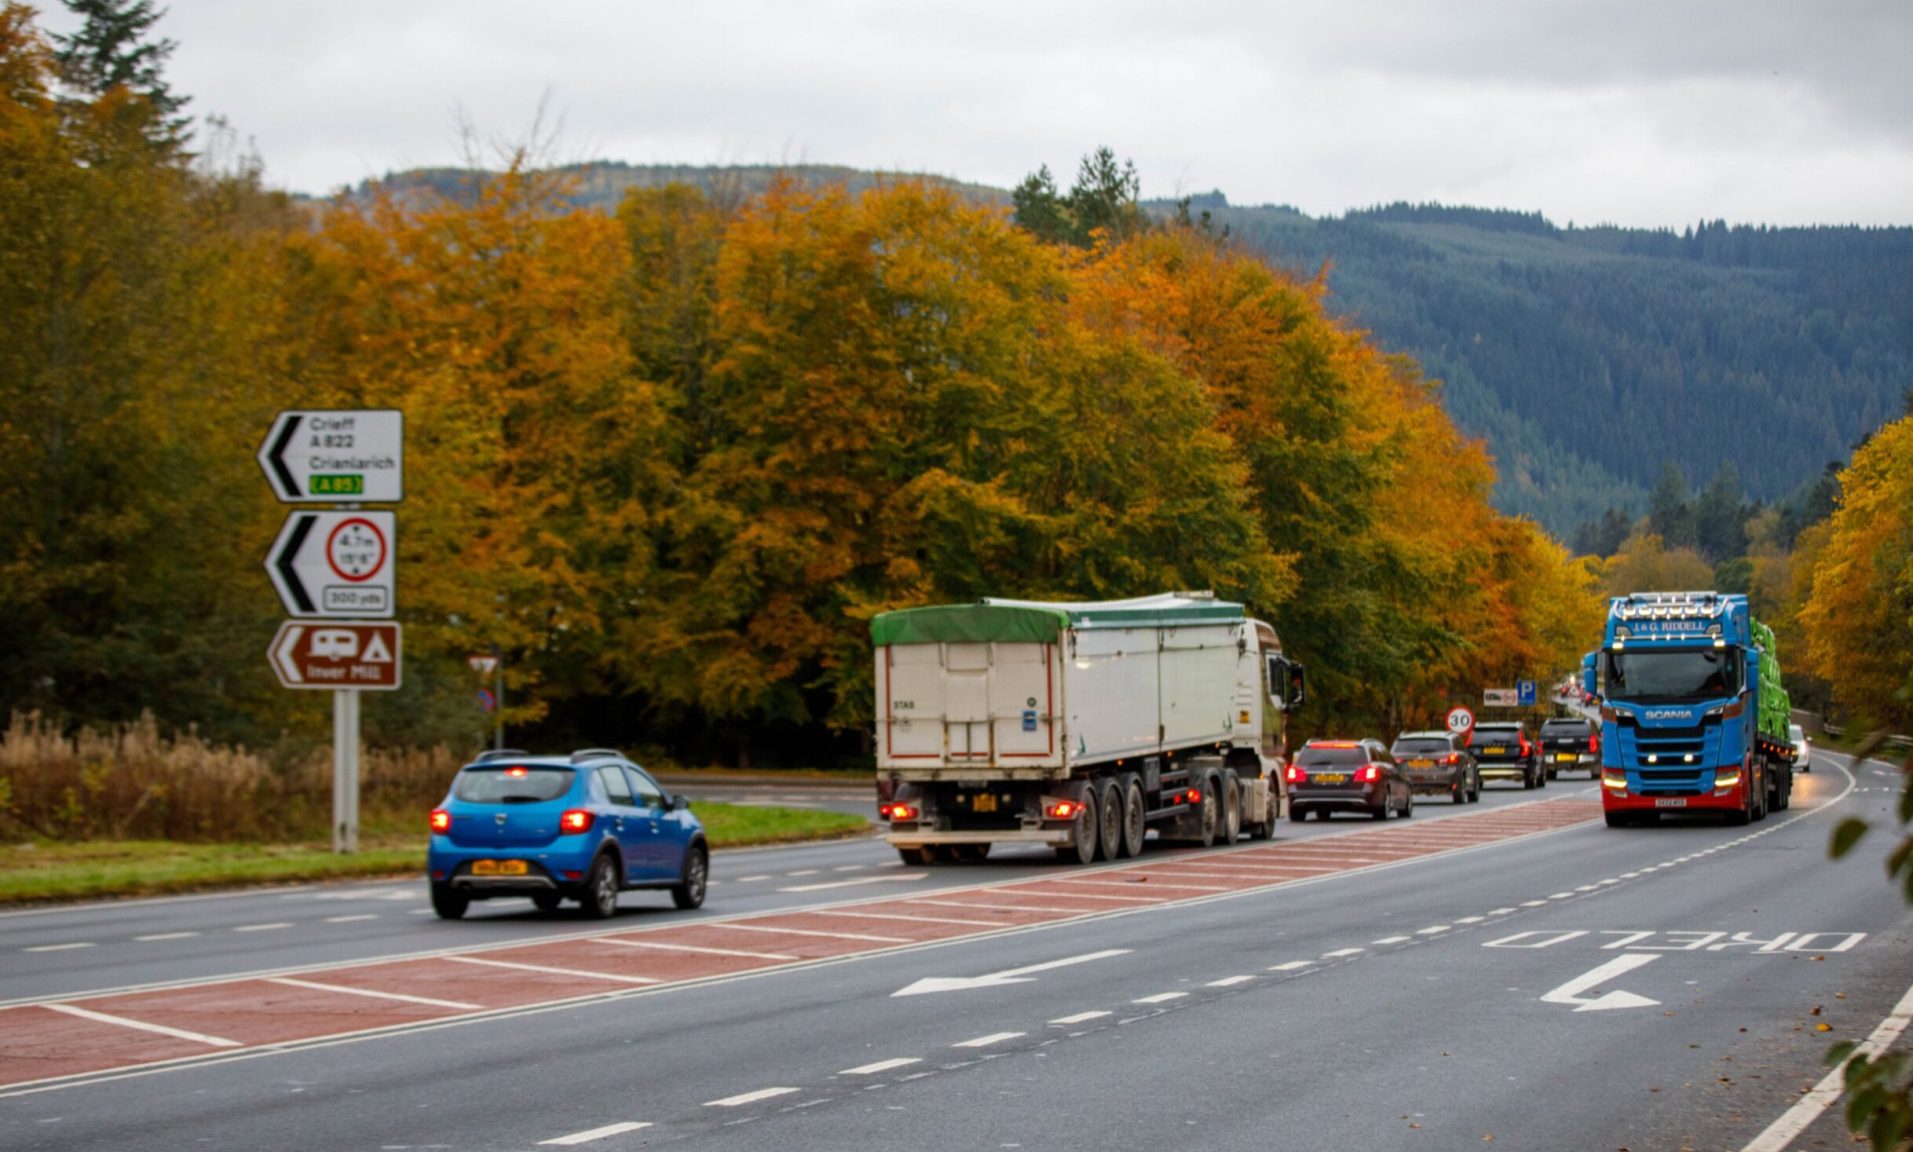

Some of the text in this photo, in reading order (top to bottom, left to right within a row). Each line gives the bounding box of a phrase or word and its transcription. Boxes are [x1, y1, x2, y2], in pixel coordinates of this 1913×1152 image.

[309, 418, 355, 431] Crieff
[310, 435, 354, 448] A 822
[309, 456, 395, 470] Crianlarich
[1661, 621, 1706, 632] RIDDELL
[306, 665, 381, 679] Inver Mill
[1521, 682, 1533, 698] P
[1450, 714, 1470, 727] 30
[1645, 709, 1693, 720] SCANIA
